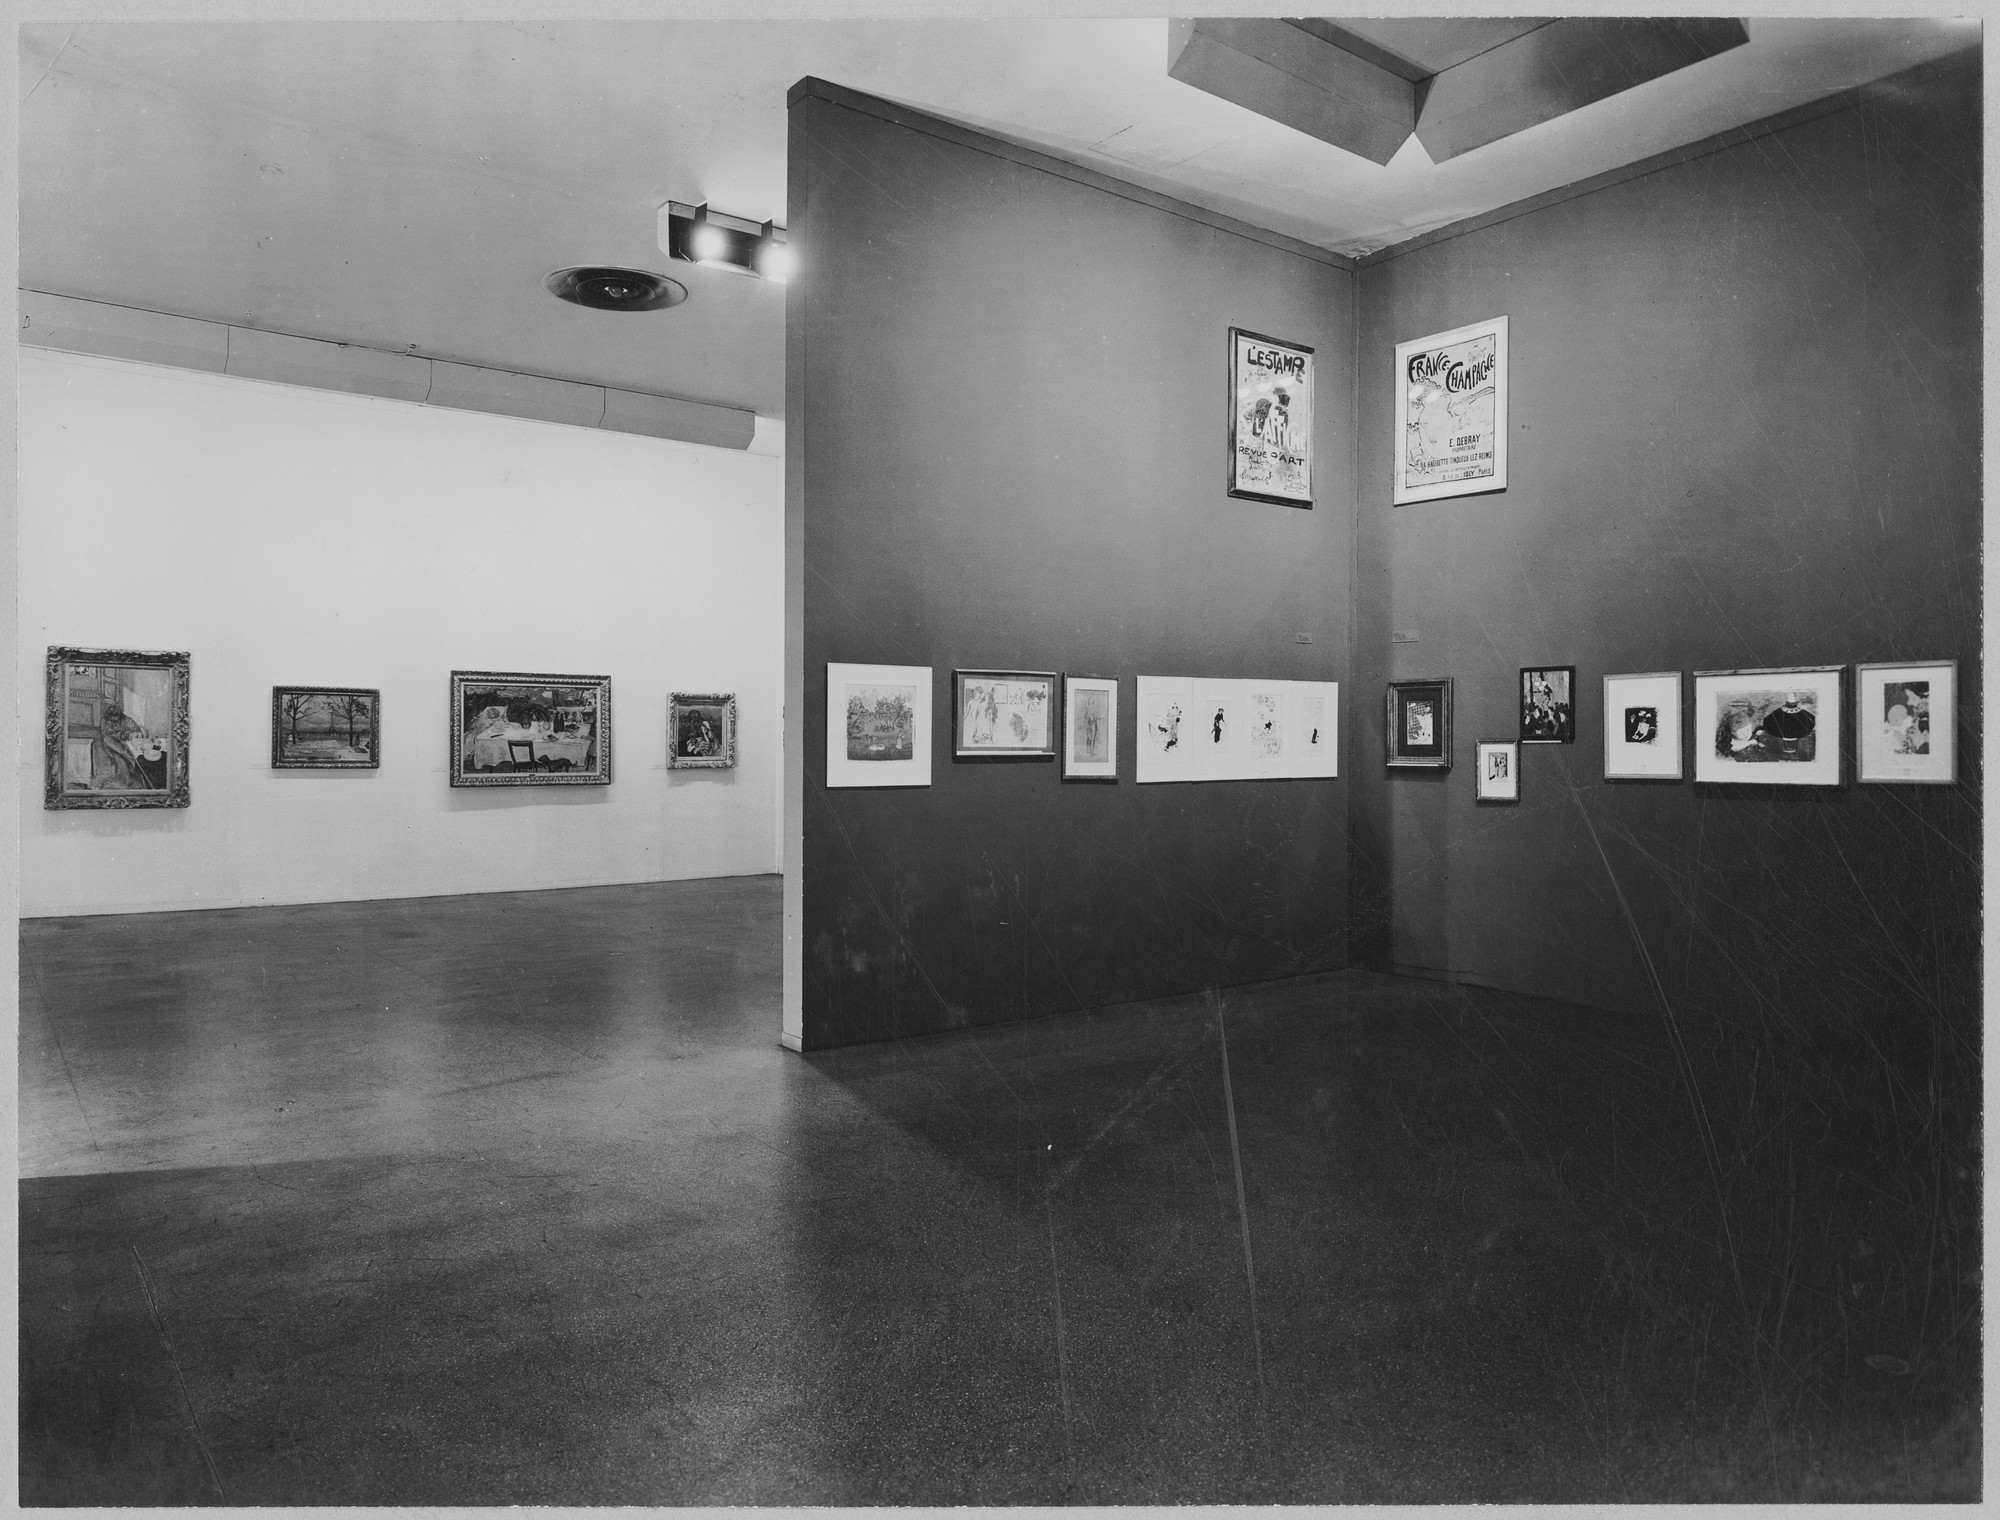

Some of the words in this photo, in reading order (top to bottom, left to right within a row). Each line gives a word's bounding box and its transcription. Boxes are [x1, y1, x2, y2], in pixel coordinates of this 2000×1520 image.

[1446, 353, 1494, 393] CHAMPAGNE
[1457, 434, 1481, 446] DEBRAY
[1239, 446, 1268, 458] REVUE
[1271, 451, 1305, 466] D'ART
